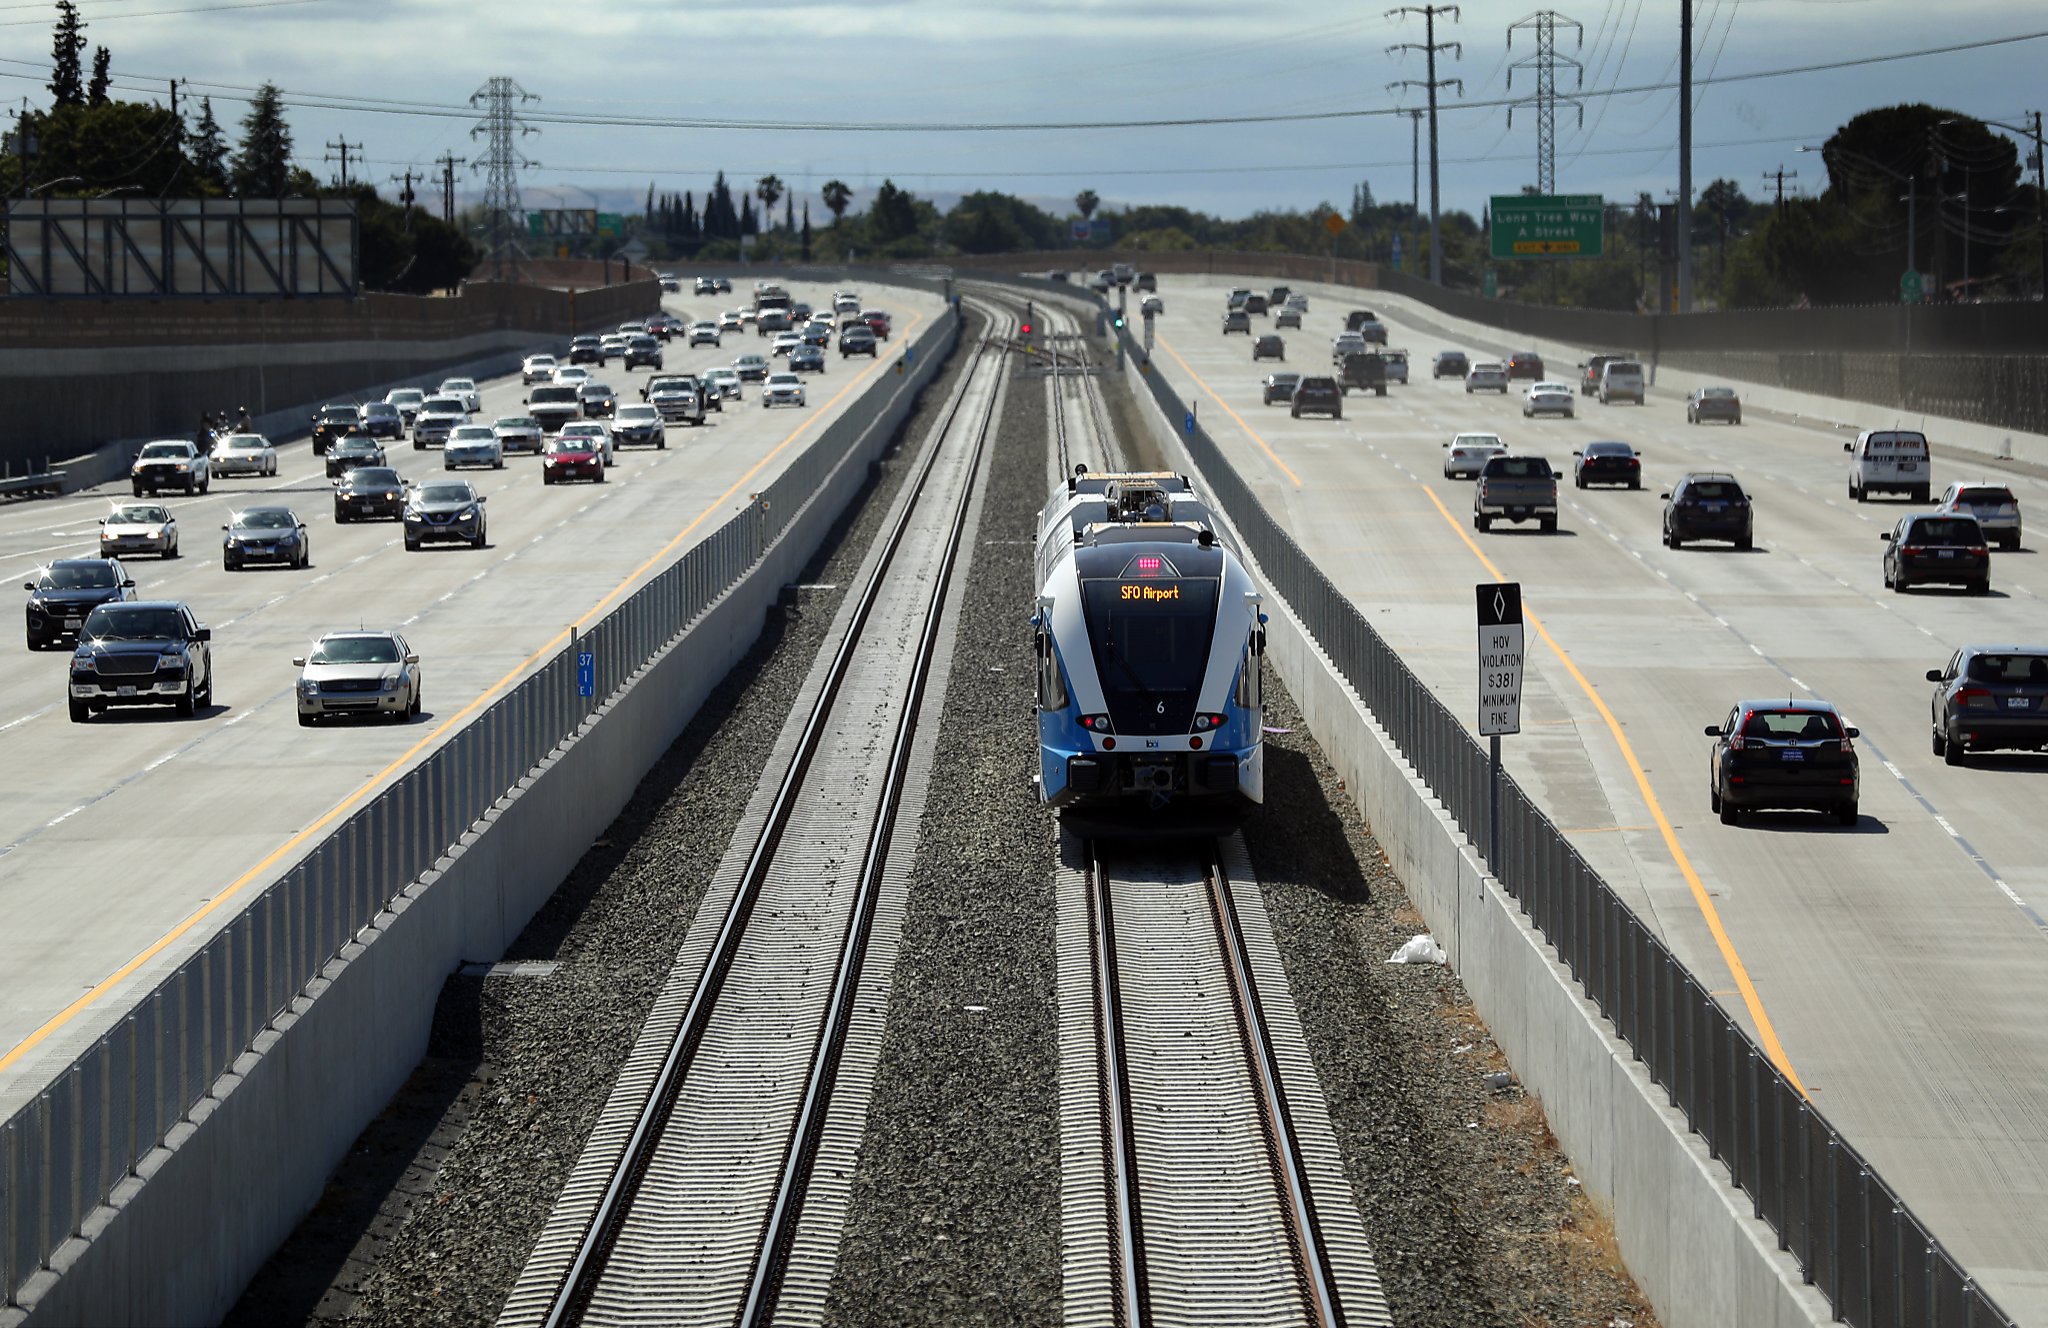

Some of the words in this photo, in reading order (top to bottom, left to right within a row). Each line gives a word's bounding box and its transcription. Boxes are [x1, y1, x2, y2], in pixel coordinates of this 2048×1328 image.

[1497, 213, 1528, 223] Lone
[1535, 212, 1563, 222] Tree
[1570, 212, 1596, 223] Way
[1519, 227, 1527, 237] A
[1536, 226, 1575, 237] Street
[1121, 585, 1141, 599] SFO
[1143, 585, 1179, 602] Airport
[1493, 635, 1510, 649] HOV
[580, 654, 592, 666] 37
[1482, 653, 1521, 668] VIOLATION
[1488, 673, 1514, 689] $381
[1157, 700, 1165, 714] 6
[1482, 693, 1517, 708] MINIMUM
[1491, 712, 1508, 726] FINE
